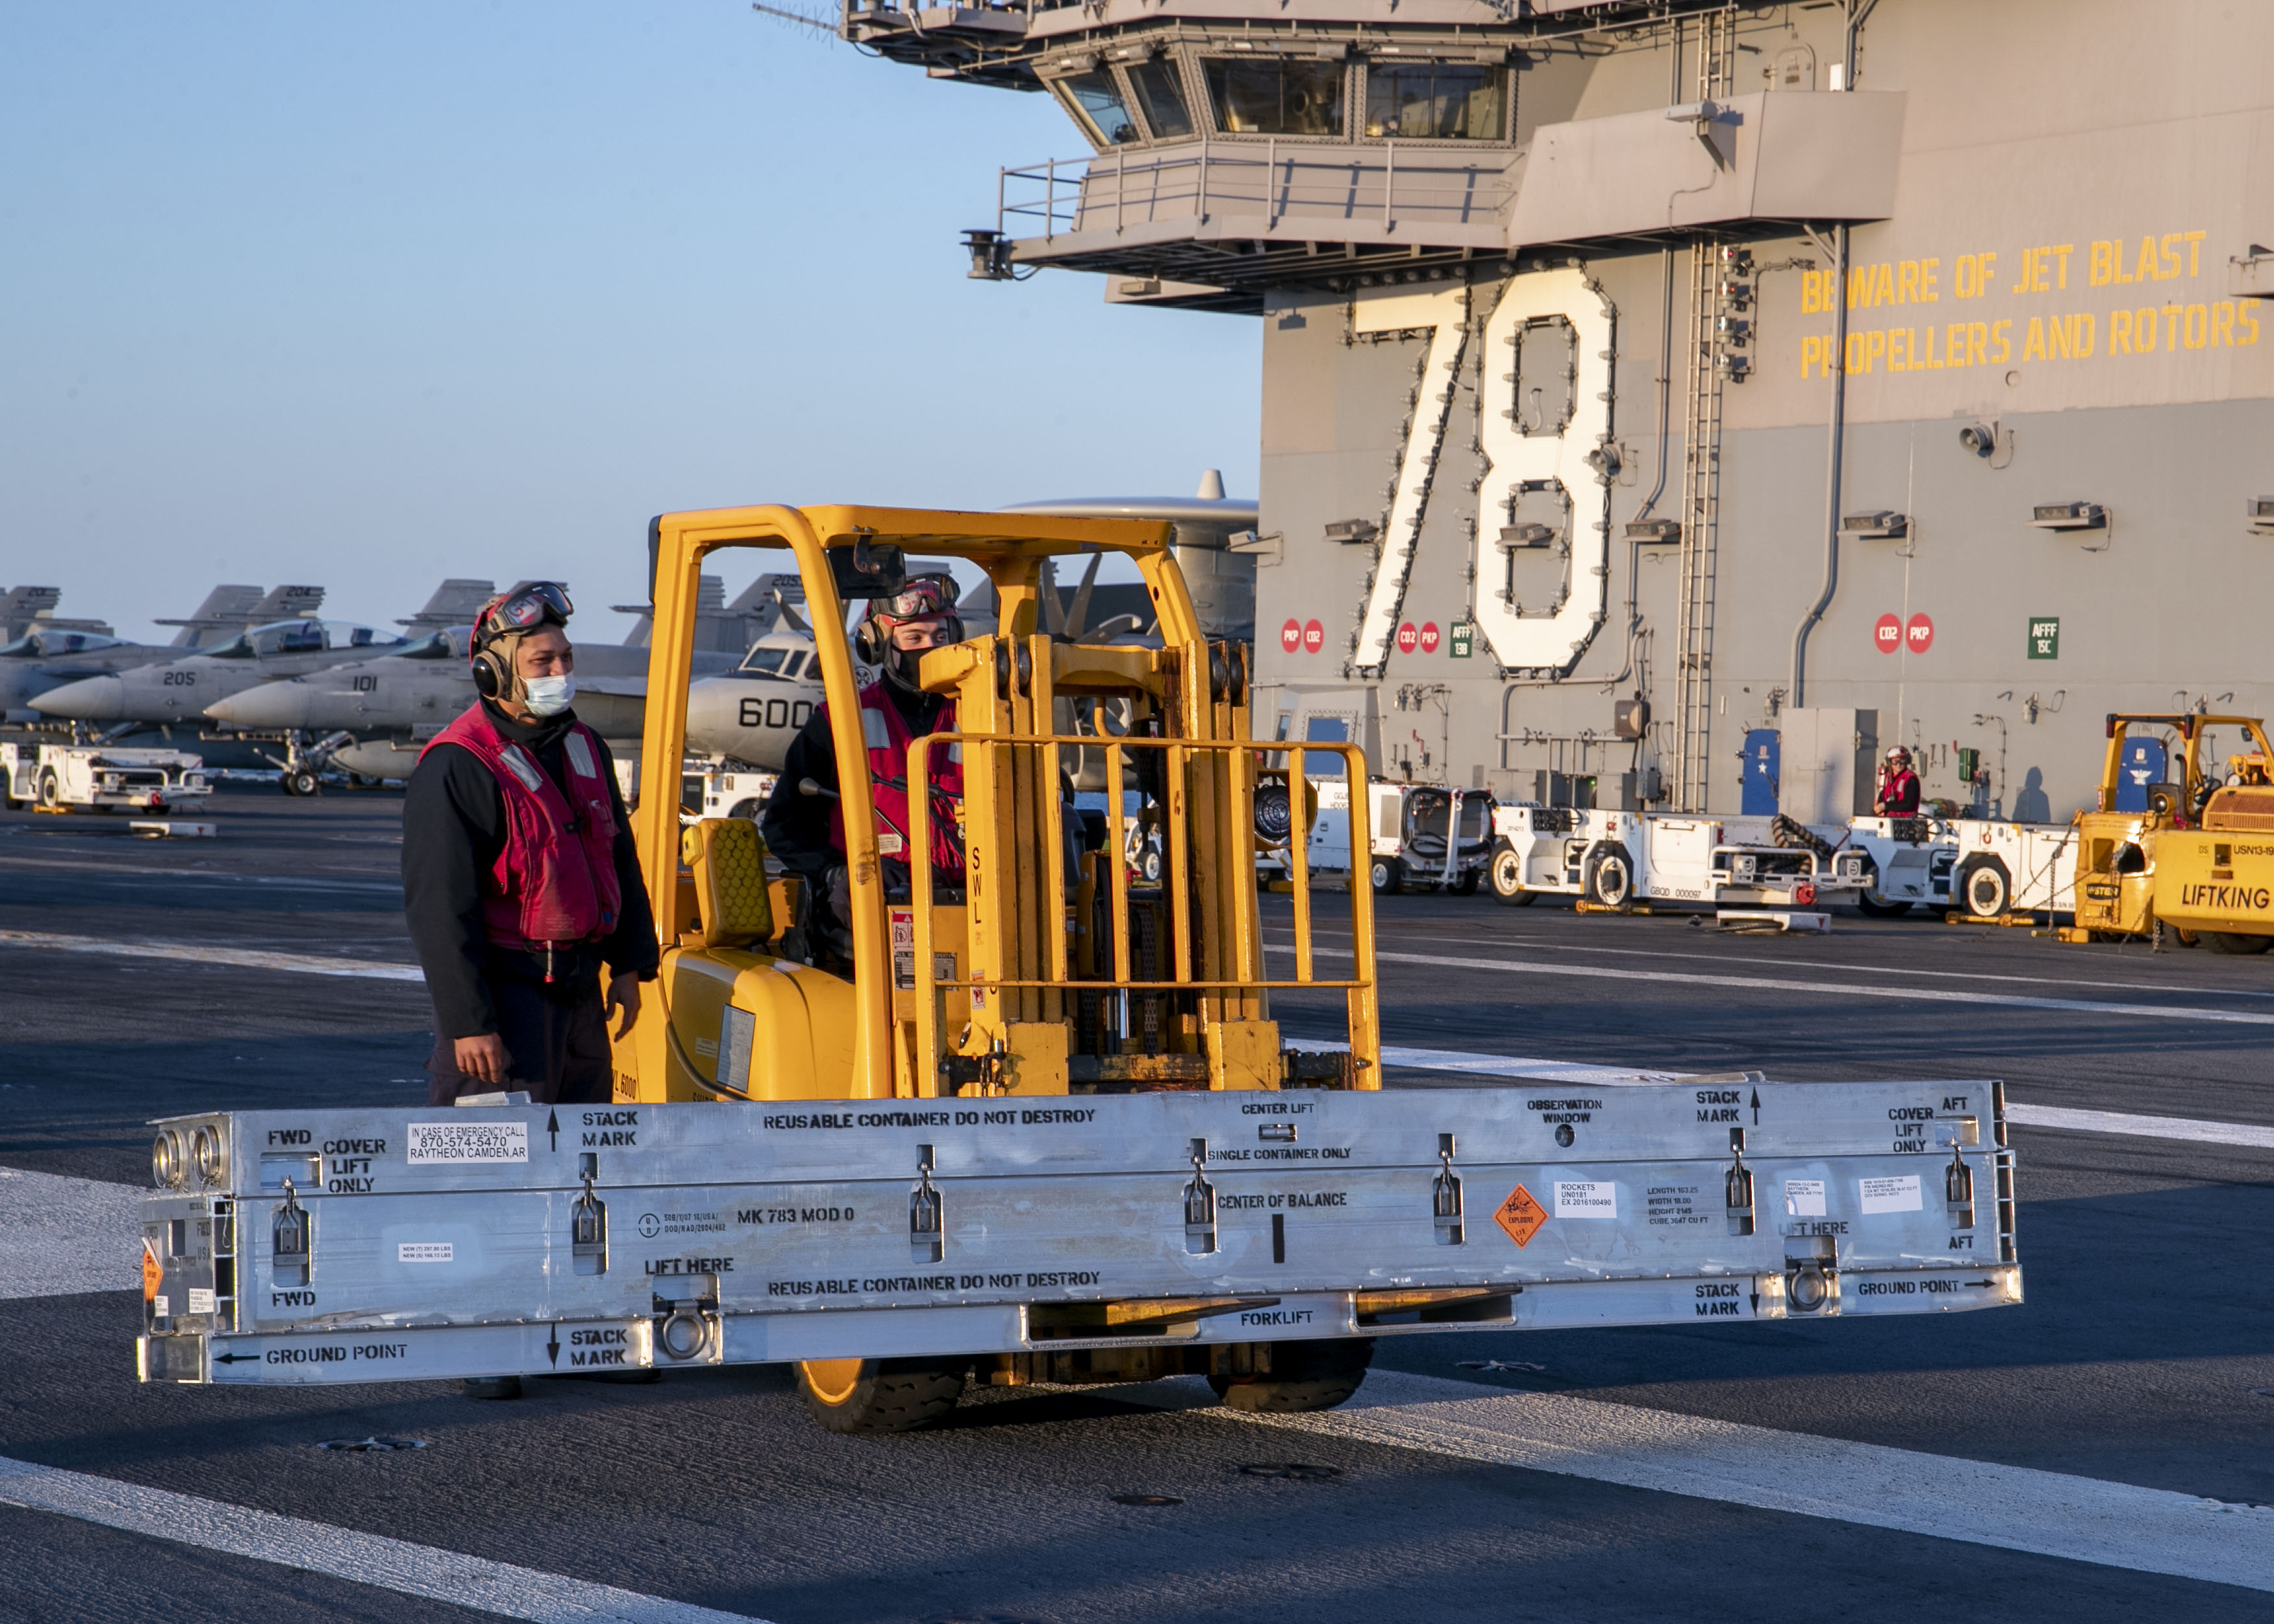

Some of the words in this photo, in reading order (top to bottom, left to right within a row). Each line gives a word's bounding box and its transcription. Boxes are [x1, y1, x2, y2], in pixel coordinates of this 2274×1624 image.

[1801, 258, 1939, 314] BEWARE
[1955, 252, 1996, 299] OF
[2012, 244, 2073, 294] JET
[2090, 231, 2206, 286] BLAST
[2023, 313, 2094, 362] AND
[2109, 299, 2260, 356] ROTORS
[1355, 266, 1614, 668] 78
[1284, 630, 1298, 642] PKP
[1306, 631, 1319, 643] CO2
[1400, 631, 1416, 643] CO2
[1879, 627, 1897, 640] CO2
[1910, 627, 1929, 640] PKP
[2032, 623, 2057, 637] AFFF
[1422, 632, 1437, 644] PKP
[2037, 640, 2051, 653] 15C
[164, 671, 195, 686] 205
[354, 676, 377, 692] 101
[739, 697, 813, 729] 600
[2199, 845, 2208, 854] DS
[2182, 884, 2270, 909] LIFTKING
[621, 1073, 636, 1100] 6000
[1527, 1099, 1602, 1110] OBSERVATION
[1696, 1091, 1740, 1105] STACK
[1942, 1097, 1968, 1110] AFT
[1242, 1104, 1287, 1115] CENTER
[1291, 1103, 1315, 1114] LIFT
[1697, 1108, 1740, 1122] MARK
[1888, 1107, 1934, 1121] COVER
[582, 1111, 638, 1127] STACK
[764, 1113, 853, 1129] REUSABLE
[858, 1112, 949, 1127] CONTAINER
[955, 1111, 979, 1125] DO
[984, 1110, 1017, 1125] NOT
[1021, 1109, 1095, 1124] DESTROY
[1543, 1112, 1590, 1123] WINDOW
[269, 1130, 312, 1145] FWD
[412, 1127, 419, 1137] IN
[423, 1127, 442, 1137] CASE
[444, 1127, 454, 1137] OF
[457, 1127, 503, 1137] EMERGENCY
[505, 1126, 525, 1136] CALL
[1895, 1124, 1923, 1137] LIFT
[421, 1137, 507, 1147] 870-574-5470
[582, 1131, 637, 1147] MARK
[1893, 1140, 1927, 1153] ONLY
[324, 1139, 386, 1155] COVER
[410, 1148, 464, 1158] RAYTHEON
[468, 1147, 525, 1158] CAMDEN,AR
[1208, 1149, 1251, 1160] SINGLE
[1254, 1149, 1319, 1160] CONTAINER
[1322, 1148, 1351, 1158] ONLY
[332, 1158, 371, 1175] LIFT
[329, 1178, 375, 1193] ONLY
[1218, 1195, 1265, 1208] CENTER
[1268, 1194, 1285, 1207] OF
[1288, 1193, 1347, 1207] BALANCE
[738, 1210, 762, 1224] MK
[768, 1209, 796, 1223] 783
[801, 1208, 840, 1222] MOD
[1812, 1222, 1848, 1234] HERE
[1948, 1236, 1973, 1249] AFT
[645, 1259, 682, 1275] LIFT
[687, 1258, 734, 1273] HERE
[768, 1279, 858, 1296] REUSABLE
[863, 1277, 955, 1292] CONTAINER
[960, 1275, 983, 1289] DO
[989, 1274, 1022, 1288] NOT
[1027, 1271, 1101, 1287] DESTROY
[1695, 1283, 1740, 1299] STACK
[1858, 1282, 1915, 1295] GROUND
[1920, 1280, 1958, 1293] POINT
[272, 1292, 316, 1307] FWD
[1695, 1302, 1739, 1316] MARK
[1240, 1310, 1313, 1326] FORKLIFT
[571, 1330, 627, 1346] STACK
[266, 1347, 346, 1365] GROUND
[353, 1345, 407, 1360] POINT
[571, 1349, 626, 1366] MARK
